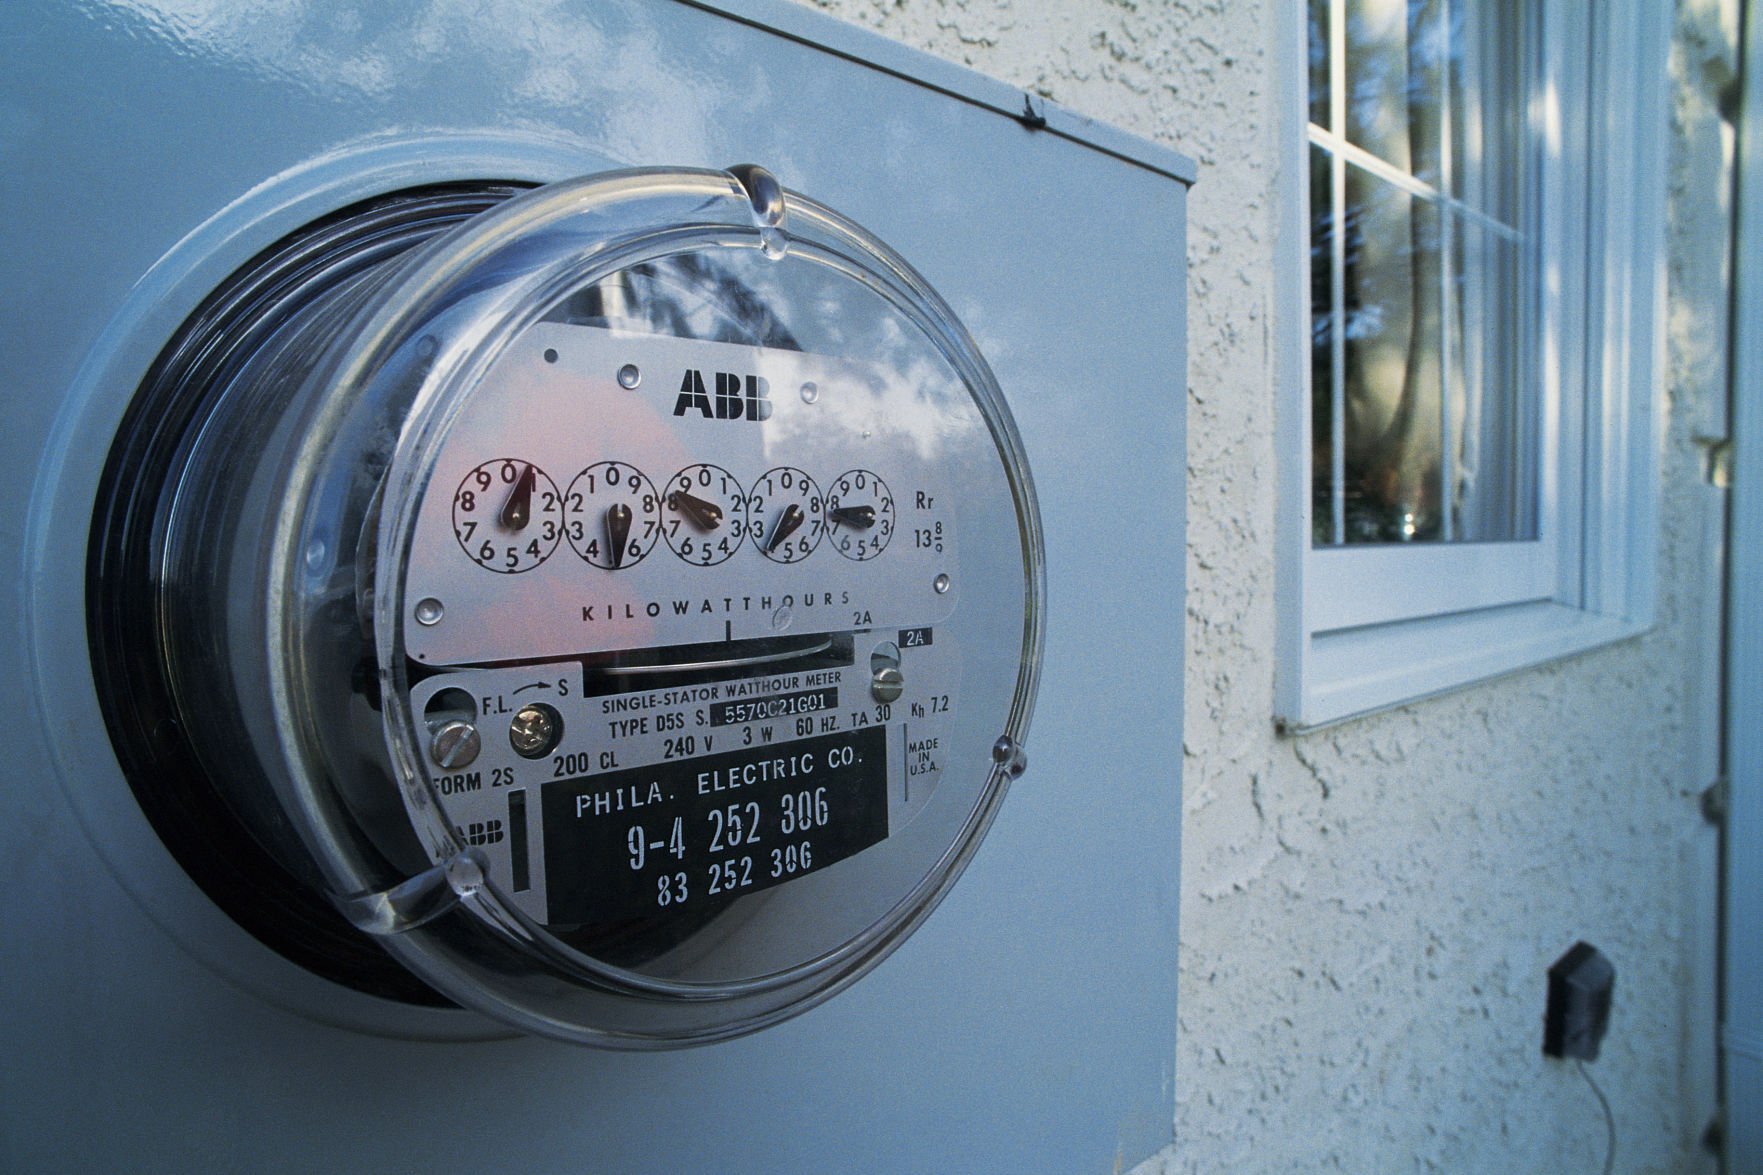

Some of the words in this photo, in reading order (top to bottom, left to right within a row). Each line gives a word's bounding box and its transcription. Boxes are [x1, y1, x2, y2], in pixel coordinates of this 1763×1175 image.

[673, 369, 773, 421] ABB
[476, 471, 492, 492] 9
[501, 463, 517, 483] 0
[530, 472, 536, 492] 1
[605, 466, 620, 486] 0
[699, 469, 711, 487] 0
[781, 472, 792, 489] 0
[855, 474, 865, 490] 0
[588, 475, 595, 494] 1
[628, 475, 641, 494] 9
[679, 476, 692, 494] 9
[720, 477, 727, 495] 1
[767, 479, 772, 496] 1
[799, 479, 810, 496] 9
[840, 480, 850, 497] 9
[872, 481, 878, 497] 1
[461, 491, 475, 512] 8
[541, 492, 555, 512] 2
[570, 493, 583, 512] 2
[642, 494, 654, 513] 8
[668, 492, 679, 511] 8
[731, 495, 742, 512] 2
[753, 495, 764, 513] 2
[810, 496, 820, 513] 8
[830, 495, 840, 511] 8
[881, 497, 889, 513] 2
[916, 491, 934, 509] Rr
[462, 522, 478, 542] 7
[542, 521, 555, 540] 3
[571, 521, 584, 540] 3
[643, 521, 656, 539] 7
[670, 520, 681, 538] 7
[731, 520, 742, 537] 3
[753, 520, 763, 538] 3
[811, 520, 821, 536] 7
[831, 520, 840, 535] 7
[880, 519, 889, 535] 3
[627, 538, 641, 557] 6
[680, 537, 693, 555] 6
[718, 537, 729, 554] 4
[799, 536, 809, 553] 6
[841, 535, 851, 550] 6
[870, 535, 879, 550] 4
[915, 529, 931, 548] 13
[480, 540, 495, 560] 6
[526, 539, 541, 558] 4
[586, 539, 599, 558] 4
[701, 543, 712, 561] 5
[783, 542, 793, 559] 5
[857, 540, 866, 556] 5
[506, 548, 519, 568] 5
[582, 591, 849, 622] KILOWATTHOURS
[853, 611, 872, 625] 2A
[906, 630, 924, 646] 2A
[482, 696, 513, 715] F.L.
[558, 678, 569, 696] S
[602, 686, 719, 714] SINGLE-STATOR
[725, 676, 799, 698] WATTHOUR
[805, 671, 842, 687] METER
[608, 717, 648, 739] TYPE
[656, 712, 684, 732] D5S
[696, 710, 708, 726] S.
[725, 693, 826, 724] 5570C21G01
[911, 702, 925, 719] Kh
[931, 695, 949, 713] 7.2
[553, 752, 589, 777] 200
[600, 751, 619, 769] CL
[663, 735, 695, 759] 240
[704, 735, 713, 751] V
[742, 726, 751, 745] 3
[761, 726, 773, 742] W
[796, 716, 813, 736] 60
[821, 716, 840, 732] HZ.
[851, 711, 868, 727] TA
[875, 704, 891, 723] 30
[908, 738, 939, 754] MADE
[918, 752, 930, 763] IN
[492, 767, 514, 787] 2S
[910, 763, 940, 776] U.S.A.
[575, 781, 674, 818] PHILA.
[697, 754, 814, 795] ELECTRIC
[828, 746, 863, 769] CO.
[628, 816, 685, 870] 9-4
[707, 801, 761, 853] 252
[781, 786, 829, 834] 306
[657, 871, 688, 907] 83
[708, 855, 753, 895] 252
[770, 841, 812, 878] 306
